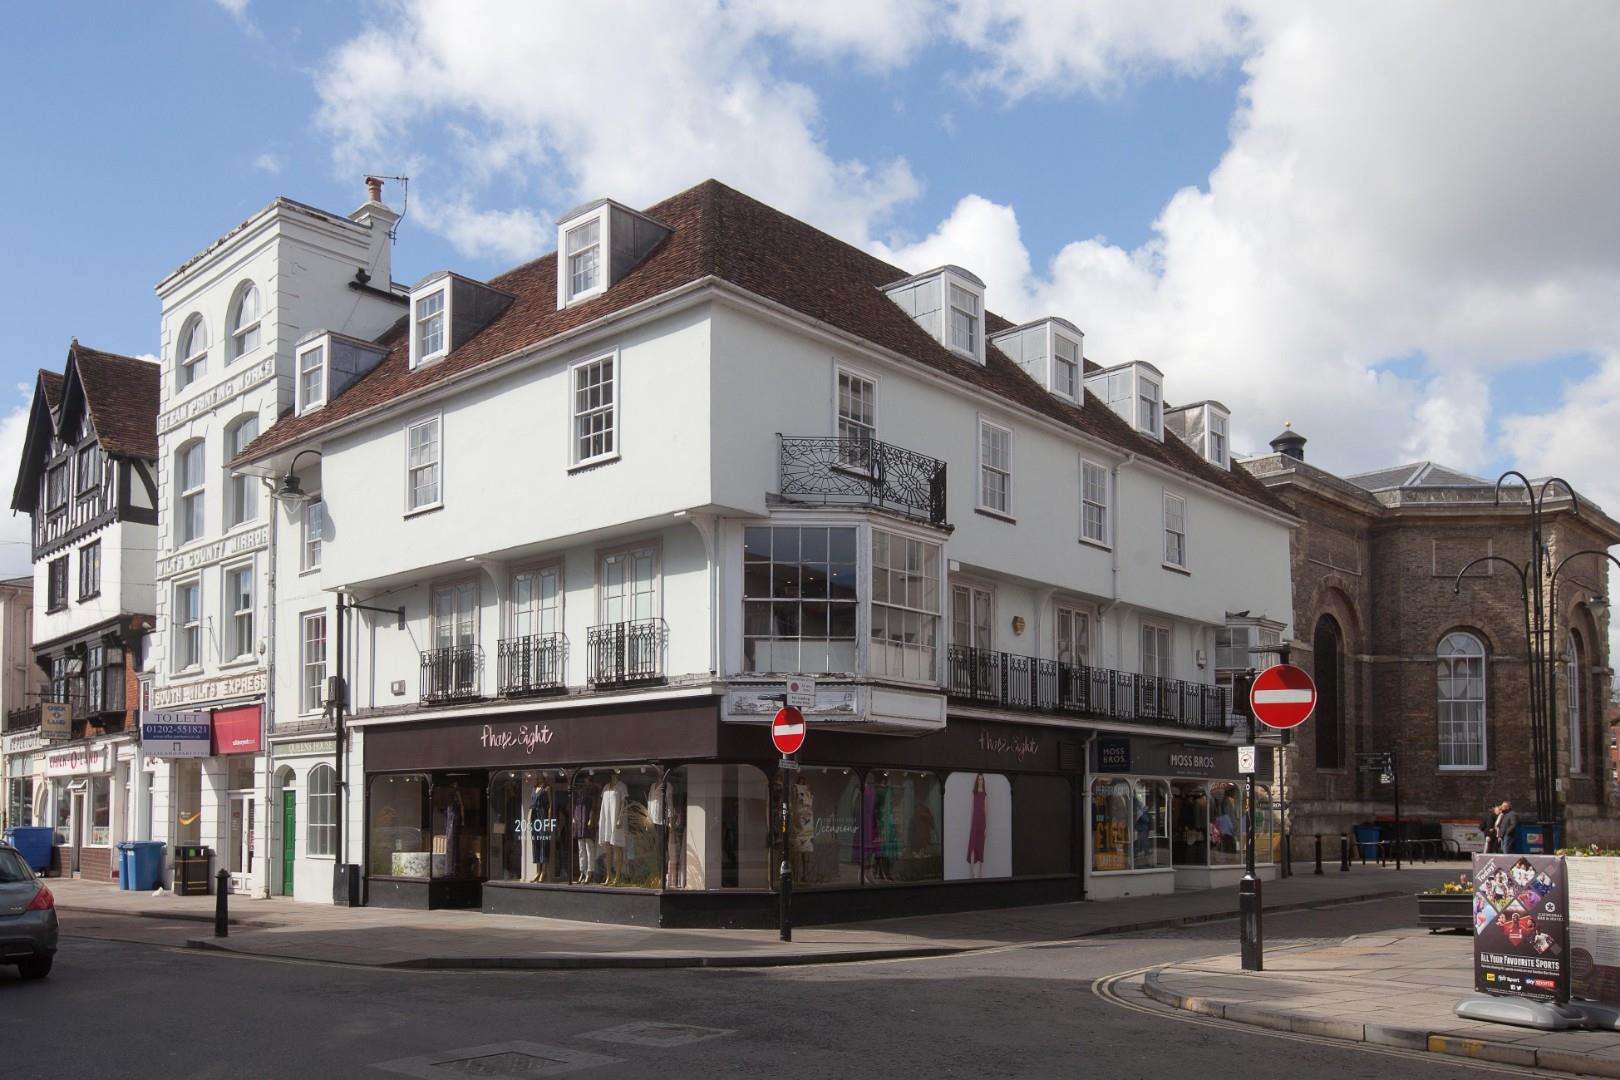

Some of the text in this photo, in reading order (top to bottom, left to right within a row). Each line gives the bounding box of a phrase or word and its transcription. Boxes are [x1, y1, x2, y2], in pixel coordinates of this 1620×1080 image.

[160, 360, 273, 429] STEAM PRINTING WORKS
[188, 542, 226, 567] COUNTY
[230, 529, 269, 554] MIRROR
[154, 685, 184, 706] SOUTH
[223, 674, 267, 697] EXPRESS
[155, 713, 201, 723] TO LET
[146, 725, 208, 734] 01202-551821
[481, 725, 554, 755] Phase Eight
[1103, 747, 1125, 755] MOSS
[1171, 754, 1193, 768] MOSS
[533, 818, 557, 832] OFF
[1480, 953, 1489, 962] ALL
[1489, 954, 1503, 965] YOUR
[1504, 955, 1535, 968] FAVOURITE
[1535, 960, 1560, 970] SPORTS
